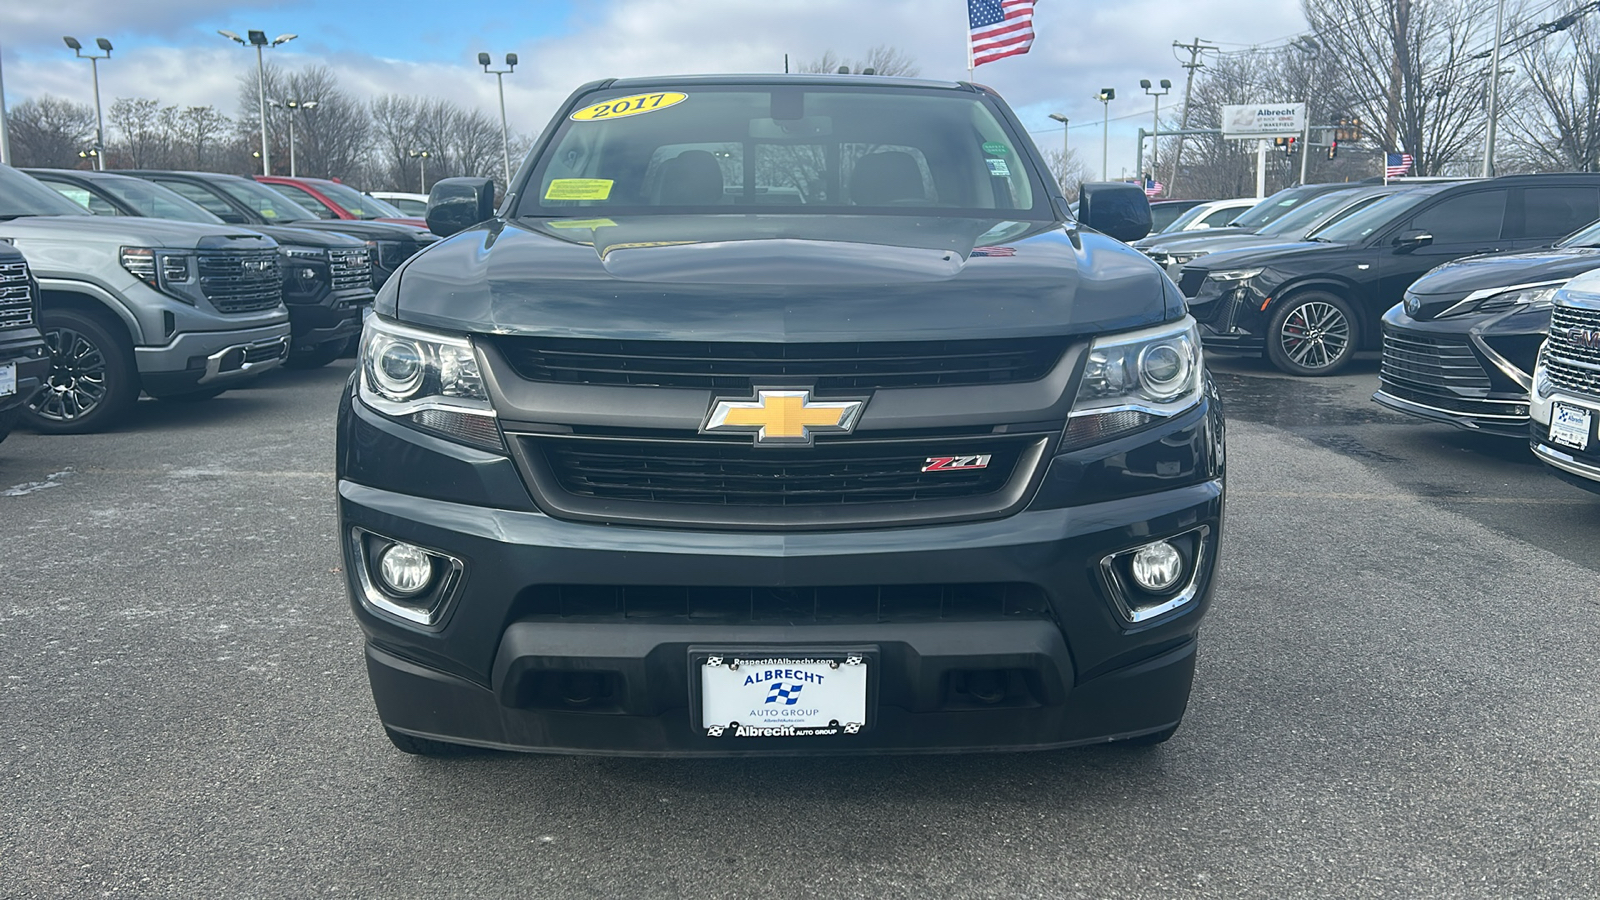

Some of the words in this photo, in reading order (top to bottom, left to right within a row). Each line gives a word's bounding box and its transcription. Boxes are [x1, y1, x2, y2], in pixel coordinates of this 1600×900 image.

[591, 94, 666, 119] 2017
[1566, 329, 1600, 348] GM
[921, 455, 992, 472] Z71
[734, 658, 835, 667] RespectAtAlbrecht.com
[743, 669, 825, 686] ALBRECHT
[749, 709, 779, 717] AUTO
[781, 708, 819, 717] GROUP
[735, 725, 796, 737] Albrecht
